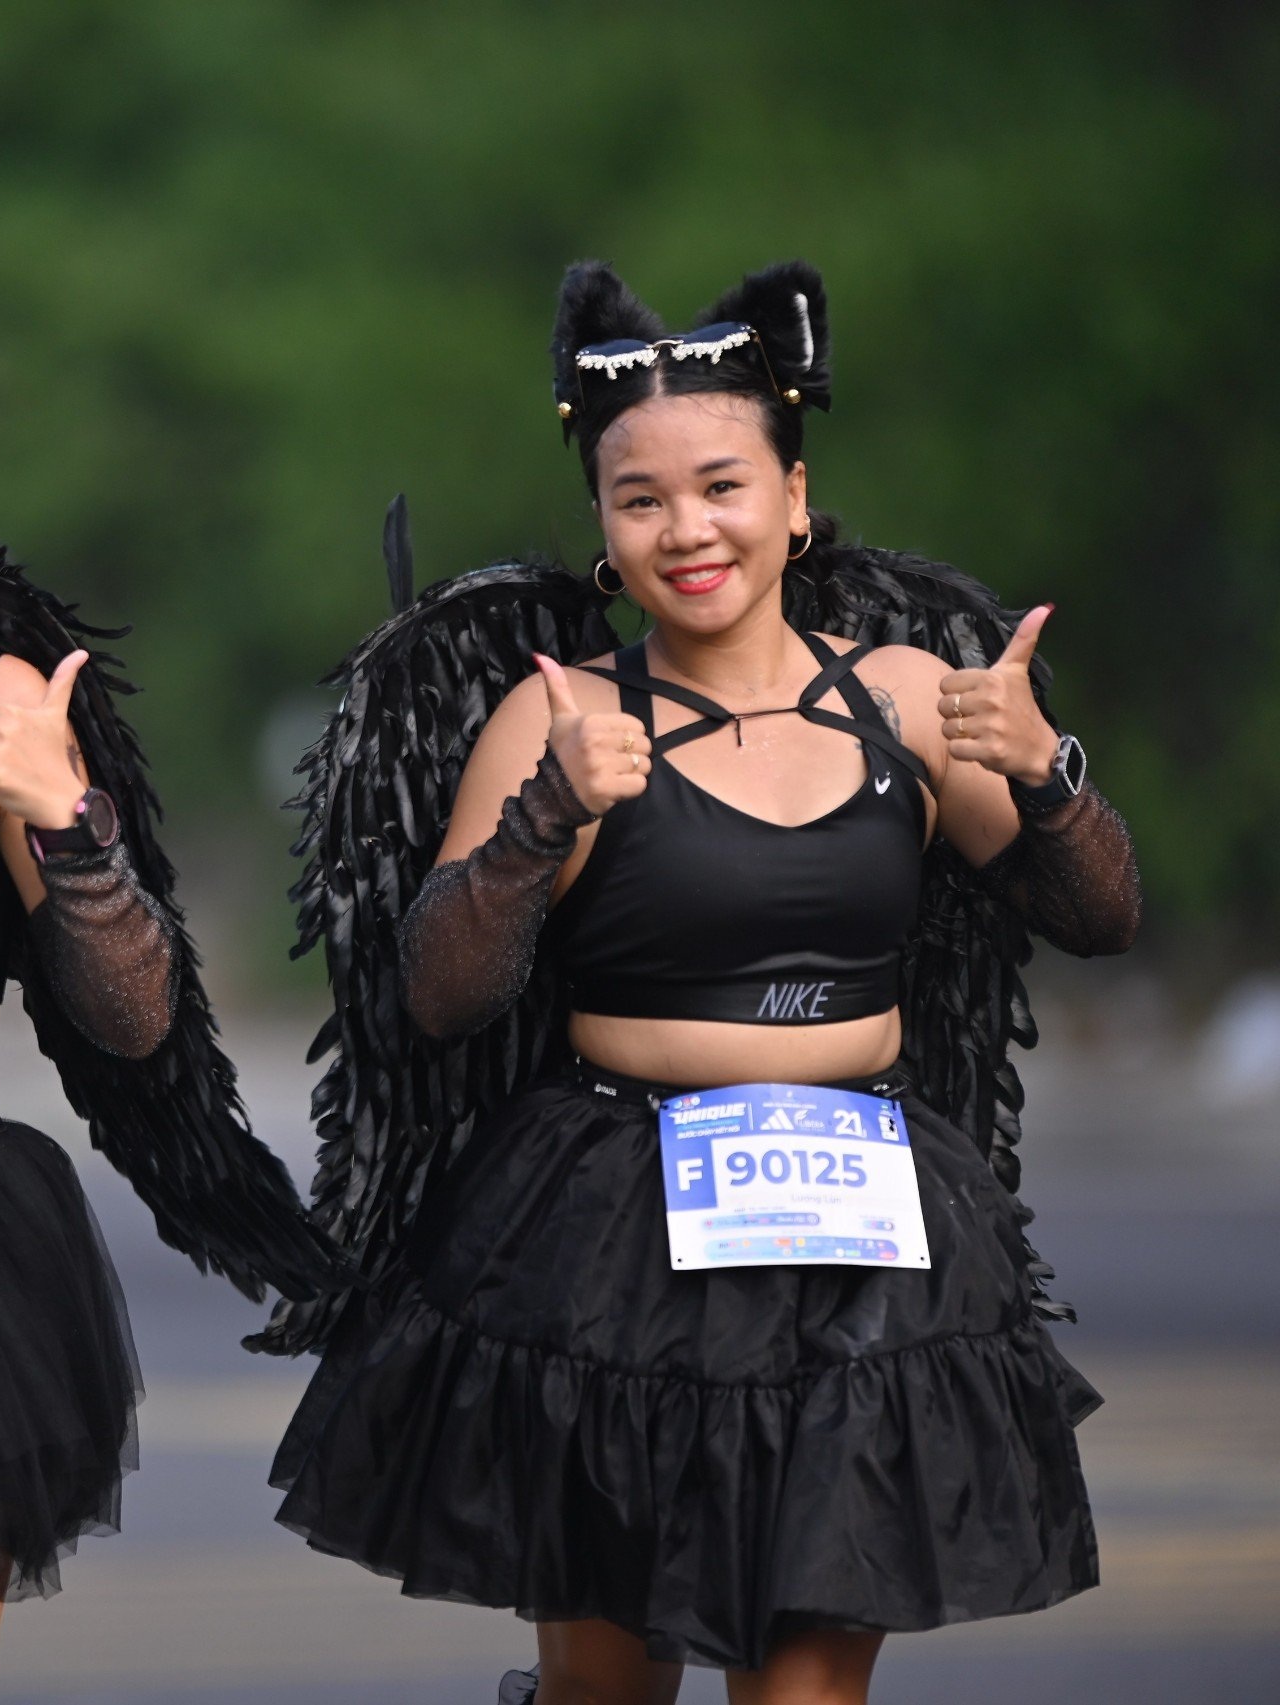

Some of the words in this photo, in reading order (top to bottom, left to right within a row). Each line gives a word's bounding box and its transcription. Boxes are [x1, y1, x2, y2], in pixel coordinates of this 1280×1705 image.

[757, 982, 836, 1018] NIKE
[668, 1103, 747, 1125] UNIQUE
[833, 1109, 863, 1137] 21
[677, 1158, 704, 1191] F
[726, 1149, 868, 1188] 90125
